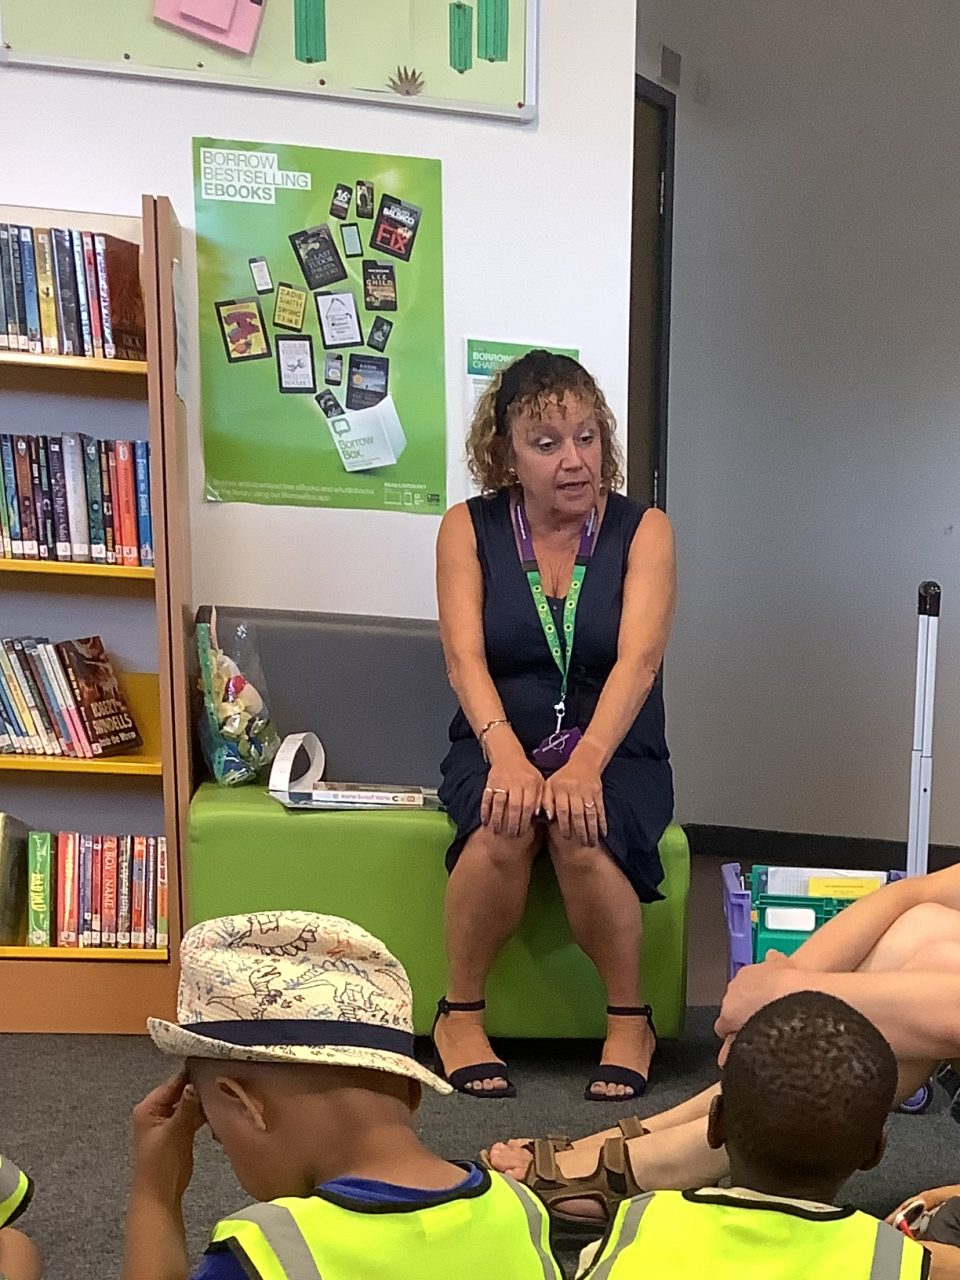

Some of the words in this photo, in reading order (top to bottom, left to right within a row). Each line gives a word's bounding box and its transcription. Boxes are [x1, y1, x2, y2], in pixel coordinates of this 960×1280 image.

[203, 150, 275, 169] BORROW
[203, 166, 308, 188] BESTSELLING
[204, 182, 273, 201] EBOOKS
[338, 436, 374, 449] Borrow
